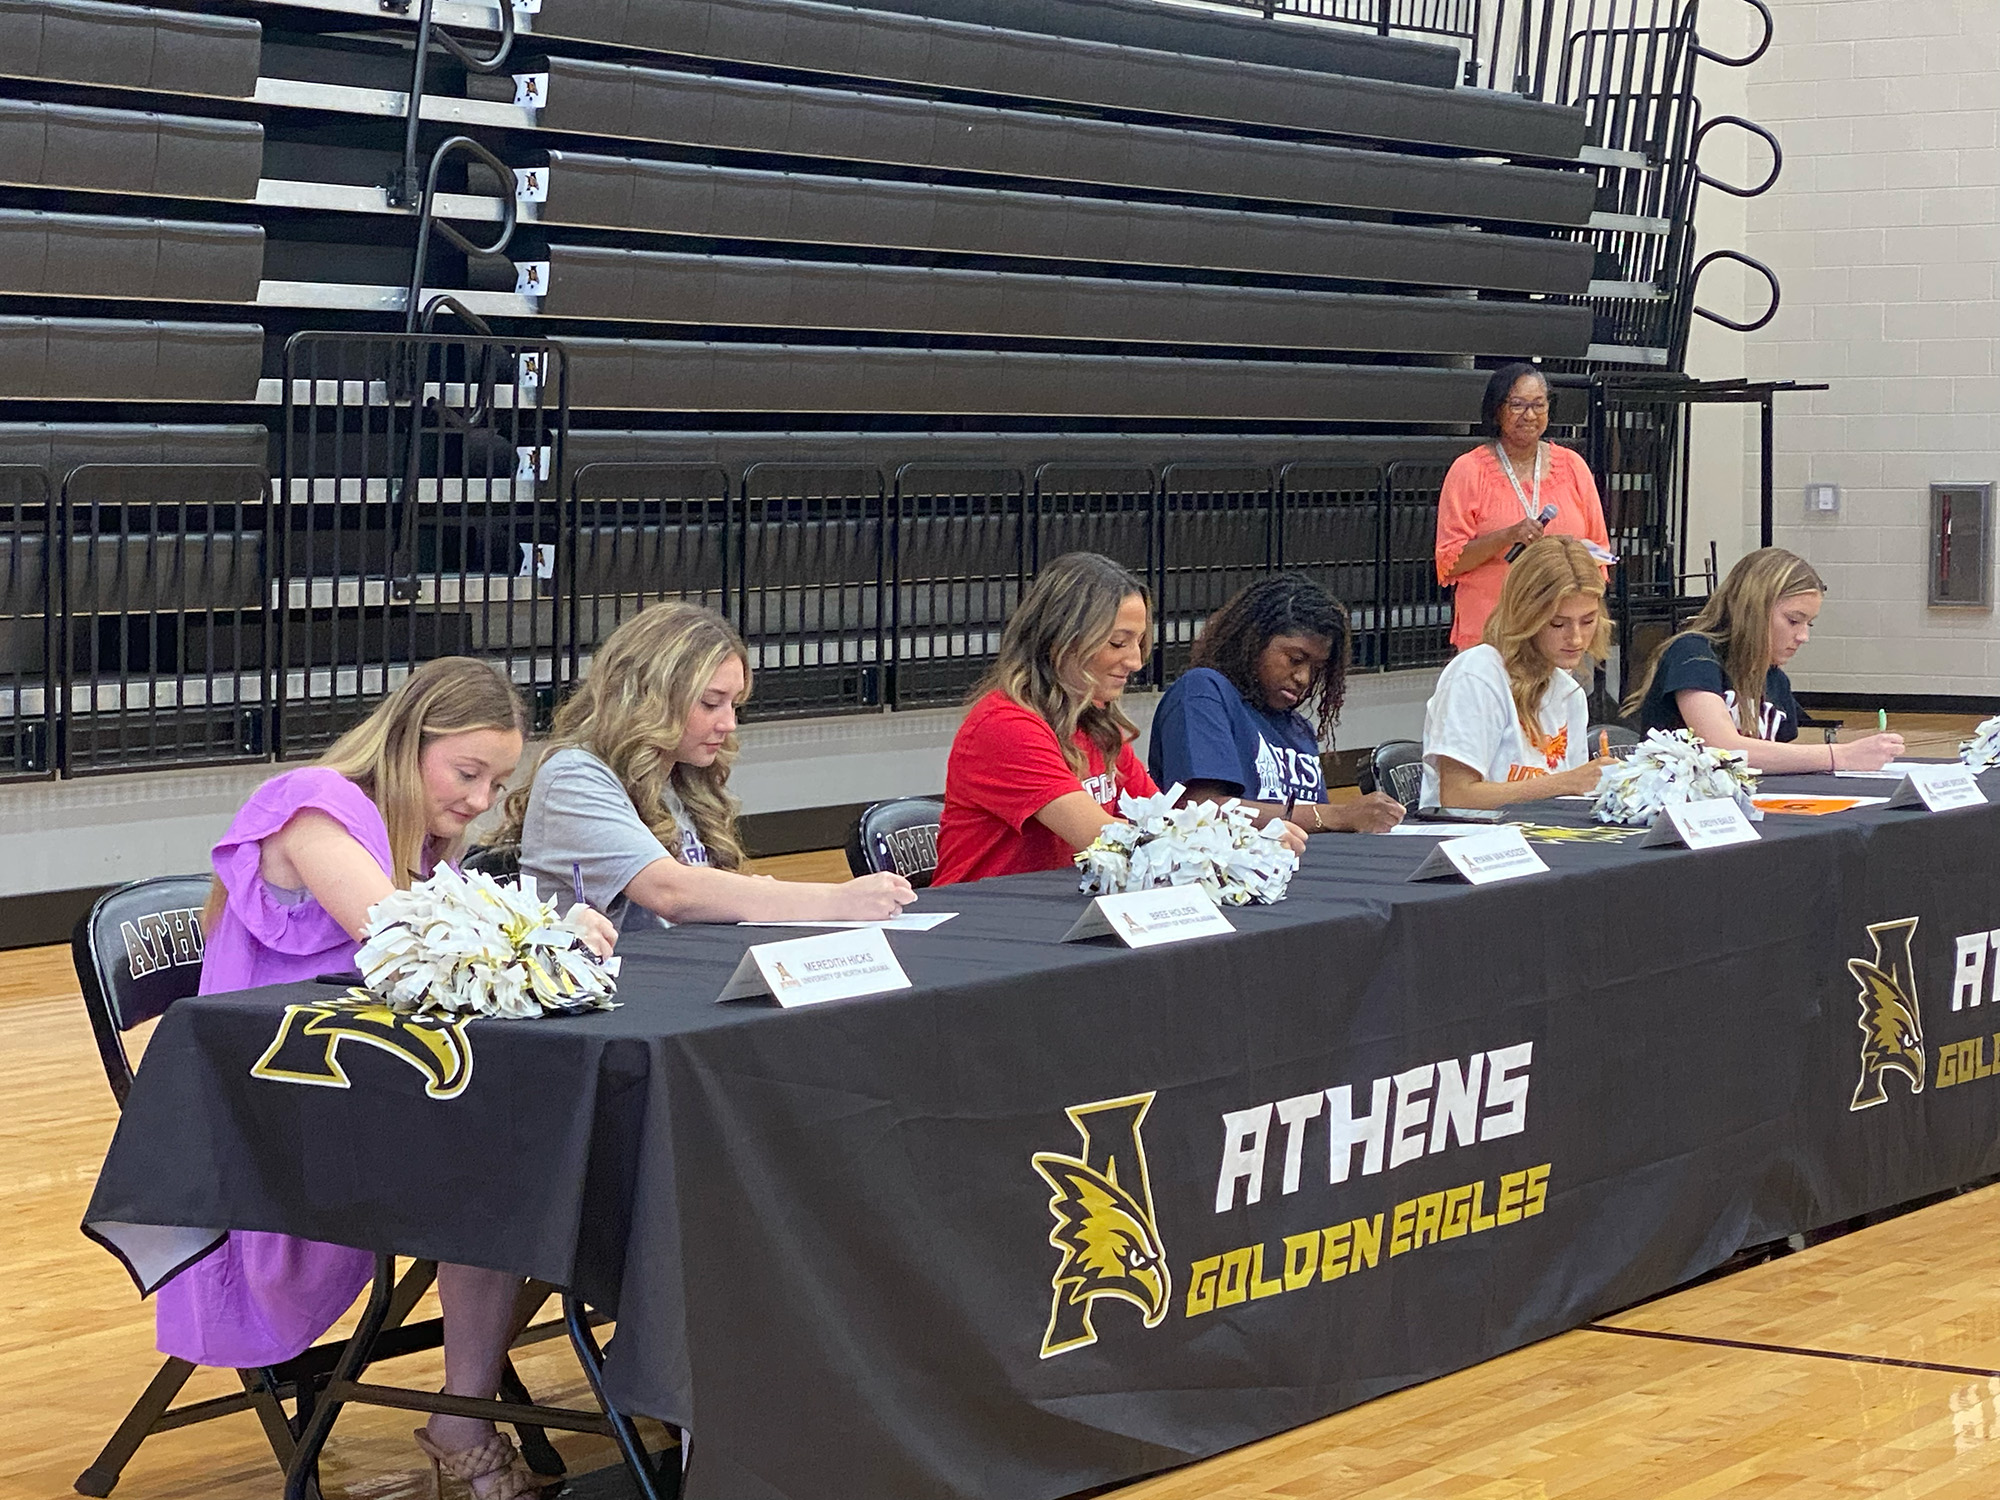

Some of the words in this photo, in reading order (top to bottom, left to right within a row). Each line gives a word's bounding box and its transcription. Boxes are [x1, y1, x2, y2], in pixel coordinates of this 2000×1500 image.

[886, 824, 940, 877] ATH
[1150, 910, 1171, 921] BREE
[1170, 907, 1199, 918] HOLDEN
[120, 907, 205, 980] ATH
[804, 957, 848, 972] MEREDITH
[848, 953, 874, 967] HICKS
[801, 974, 834, 985] UNIVERSITY
[844, 969, 863, 978] NORTH
[863, 964, 890, 974] ALABAMA
[1215, 1041, 1533, 1214] ATHENS
[1186, 1212, 1385, 1318] GOLDEN
[1390, 1163, 1552, 1258] EAGLES
